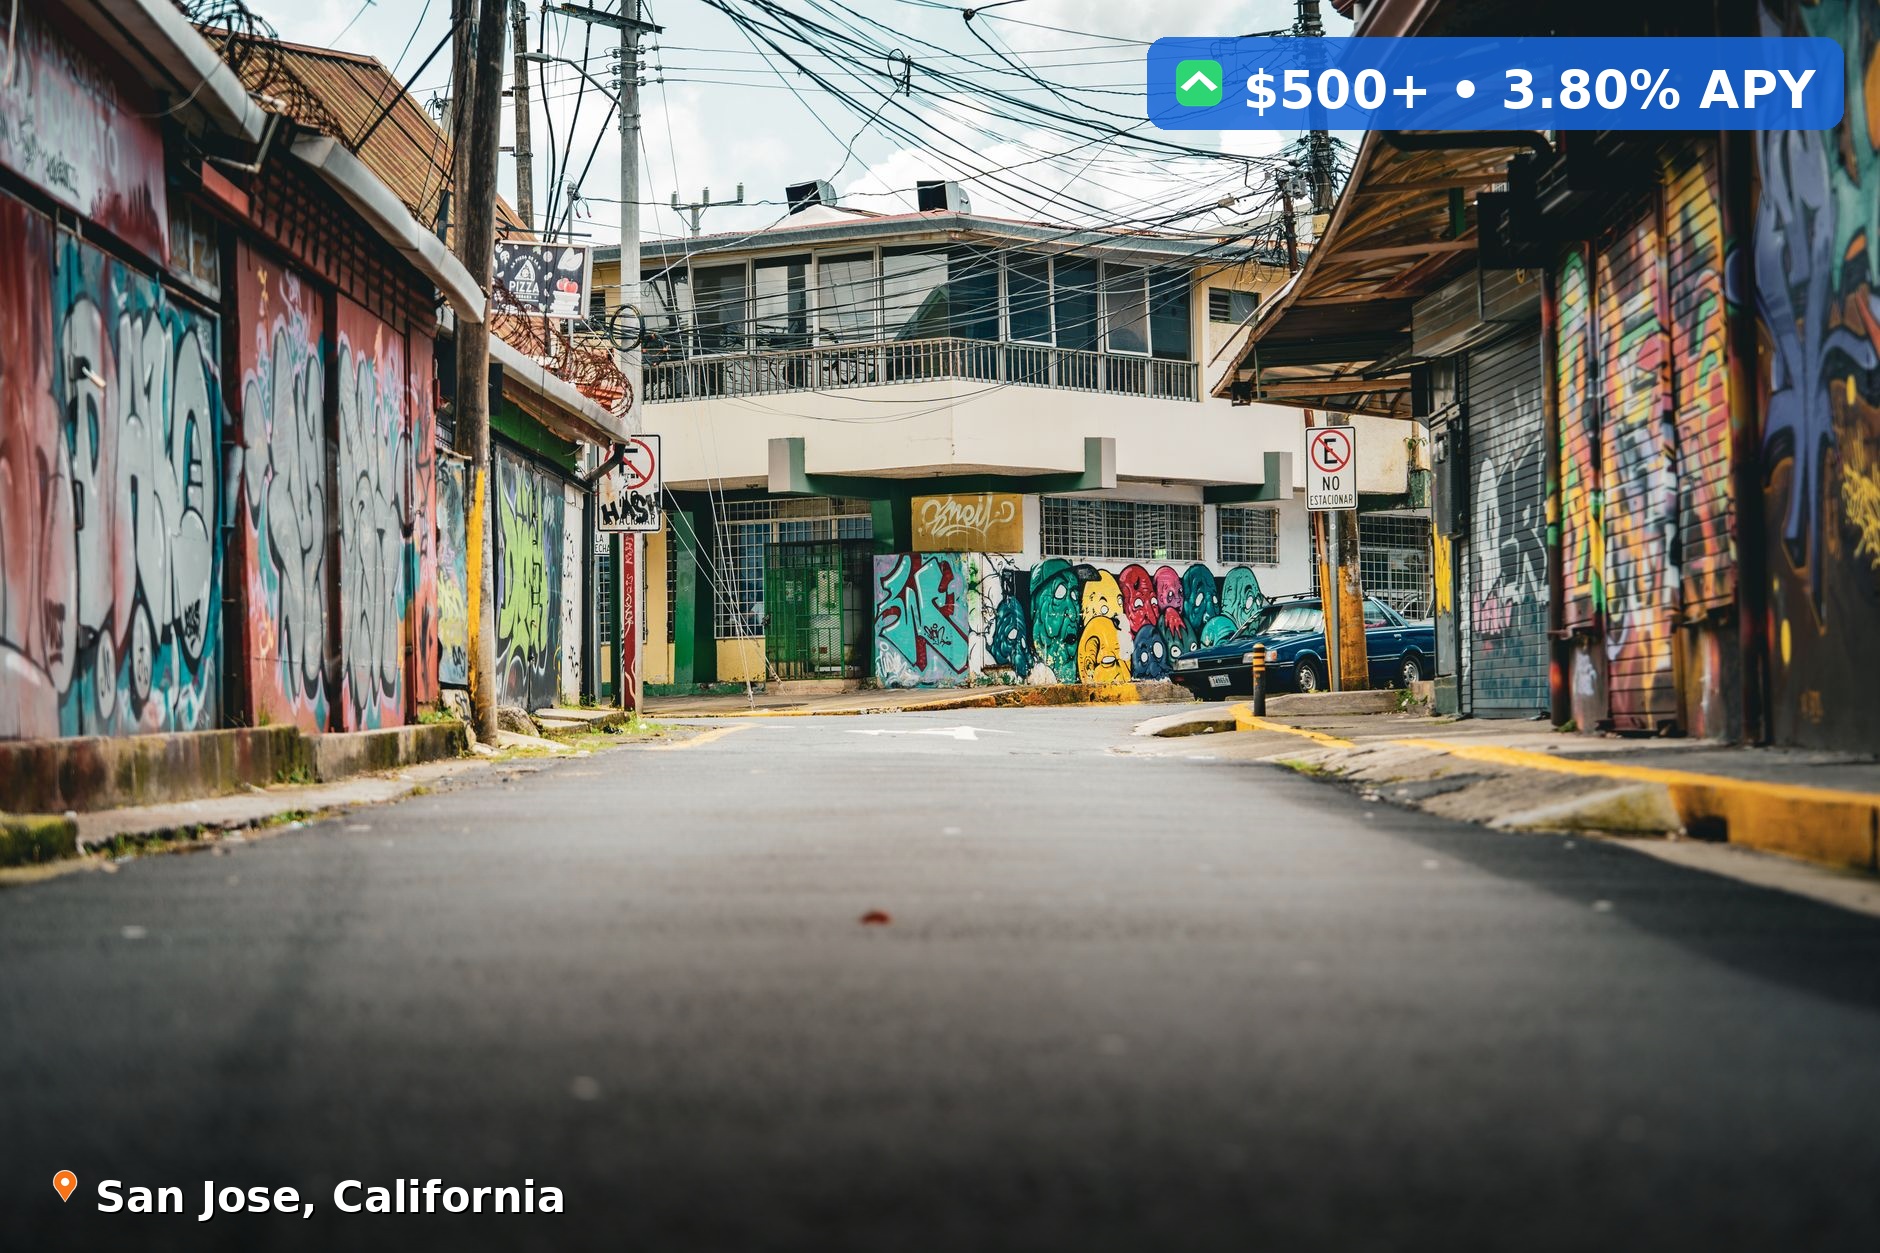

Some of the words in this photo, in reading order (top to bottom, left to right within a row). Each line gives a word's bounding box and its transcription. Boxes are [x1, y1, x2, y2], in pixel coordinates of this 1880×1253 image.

[509, 280, 539, 293] PIZZA
[1322, 475, 1340, 491] NO
[1309, 493, 1354, 506] ESTACIONAR
[595, 534, 604, 543] LA
[594, 544, 610, 553] ECHA
